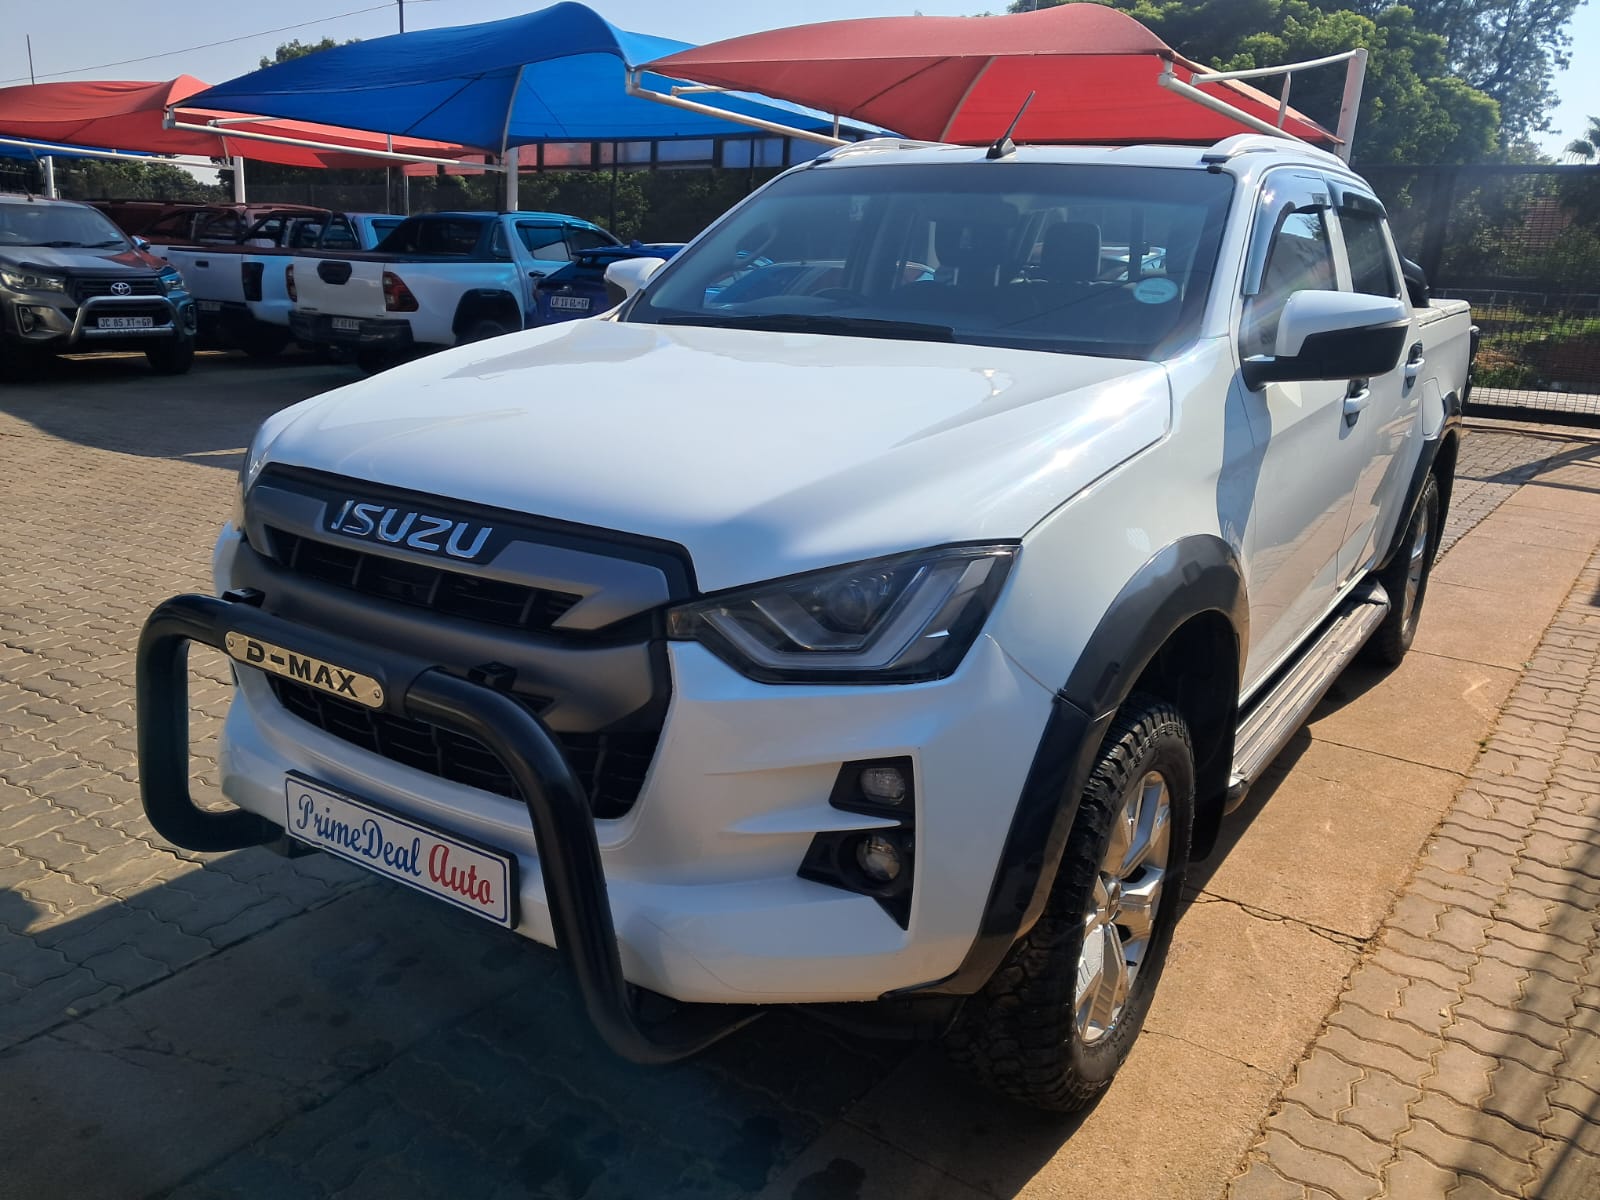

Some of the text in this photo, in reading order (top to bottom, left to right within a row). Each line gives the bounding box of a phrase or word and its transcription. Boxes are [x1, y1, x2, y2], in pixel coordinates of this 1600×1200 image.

[331, 500, 493, 559] ISUZU
[246, 639, 358, 698] D-MAX
[296, 794, 495, 905] PrimeDeal Auto
